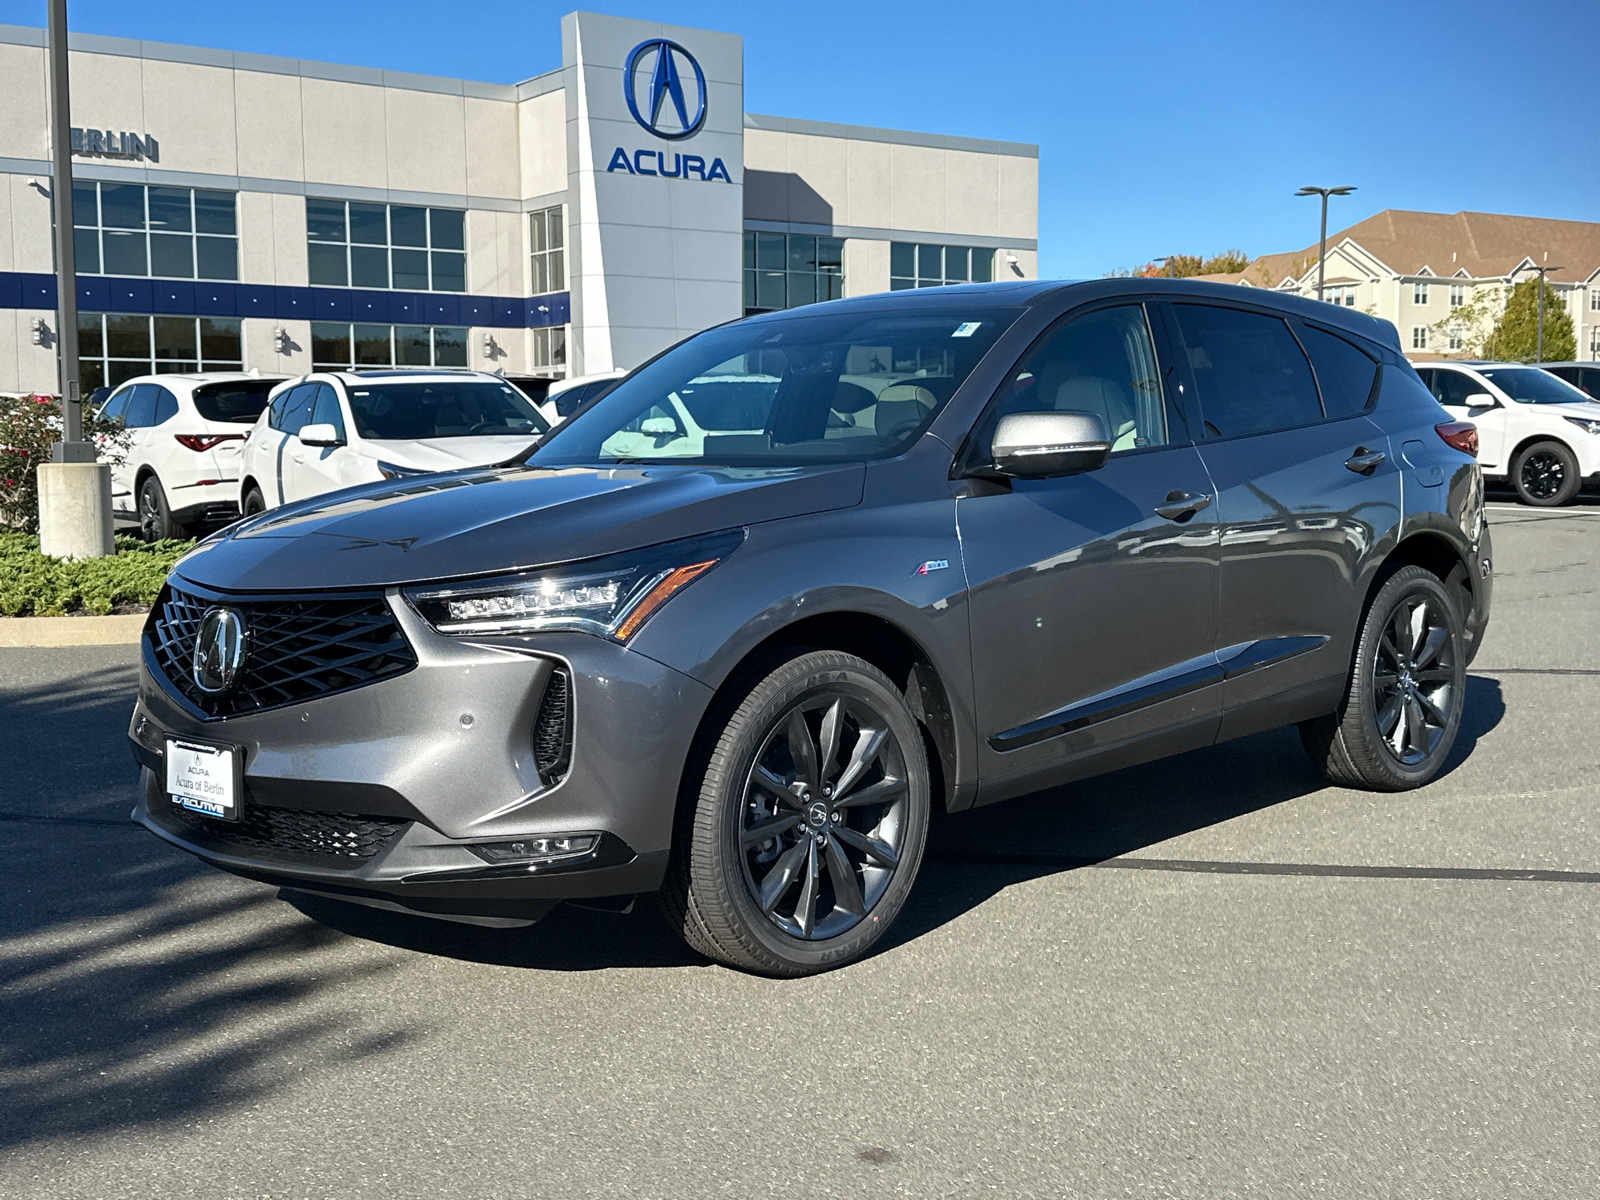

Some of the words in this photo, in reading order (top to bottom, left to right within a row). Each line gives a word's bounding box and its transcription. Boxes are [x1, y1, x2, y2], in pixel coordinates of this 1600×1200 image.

[70, 127, 153, 157] ERLIN
[607, 147, 732, 184] ACURA
[187, 766, 210, 777] ACURA
[175, 775, 193, 789] Acura
[195, 779, 202, 791] of
[204, 780, 224, 796] Berlin
[171, 794, 224, 813] EXECUTIVE
